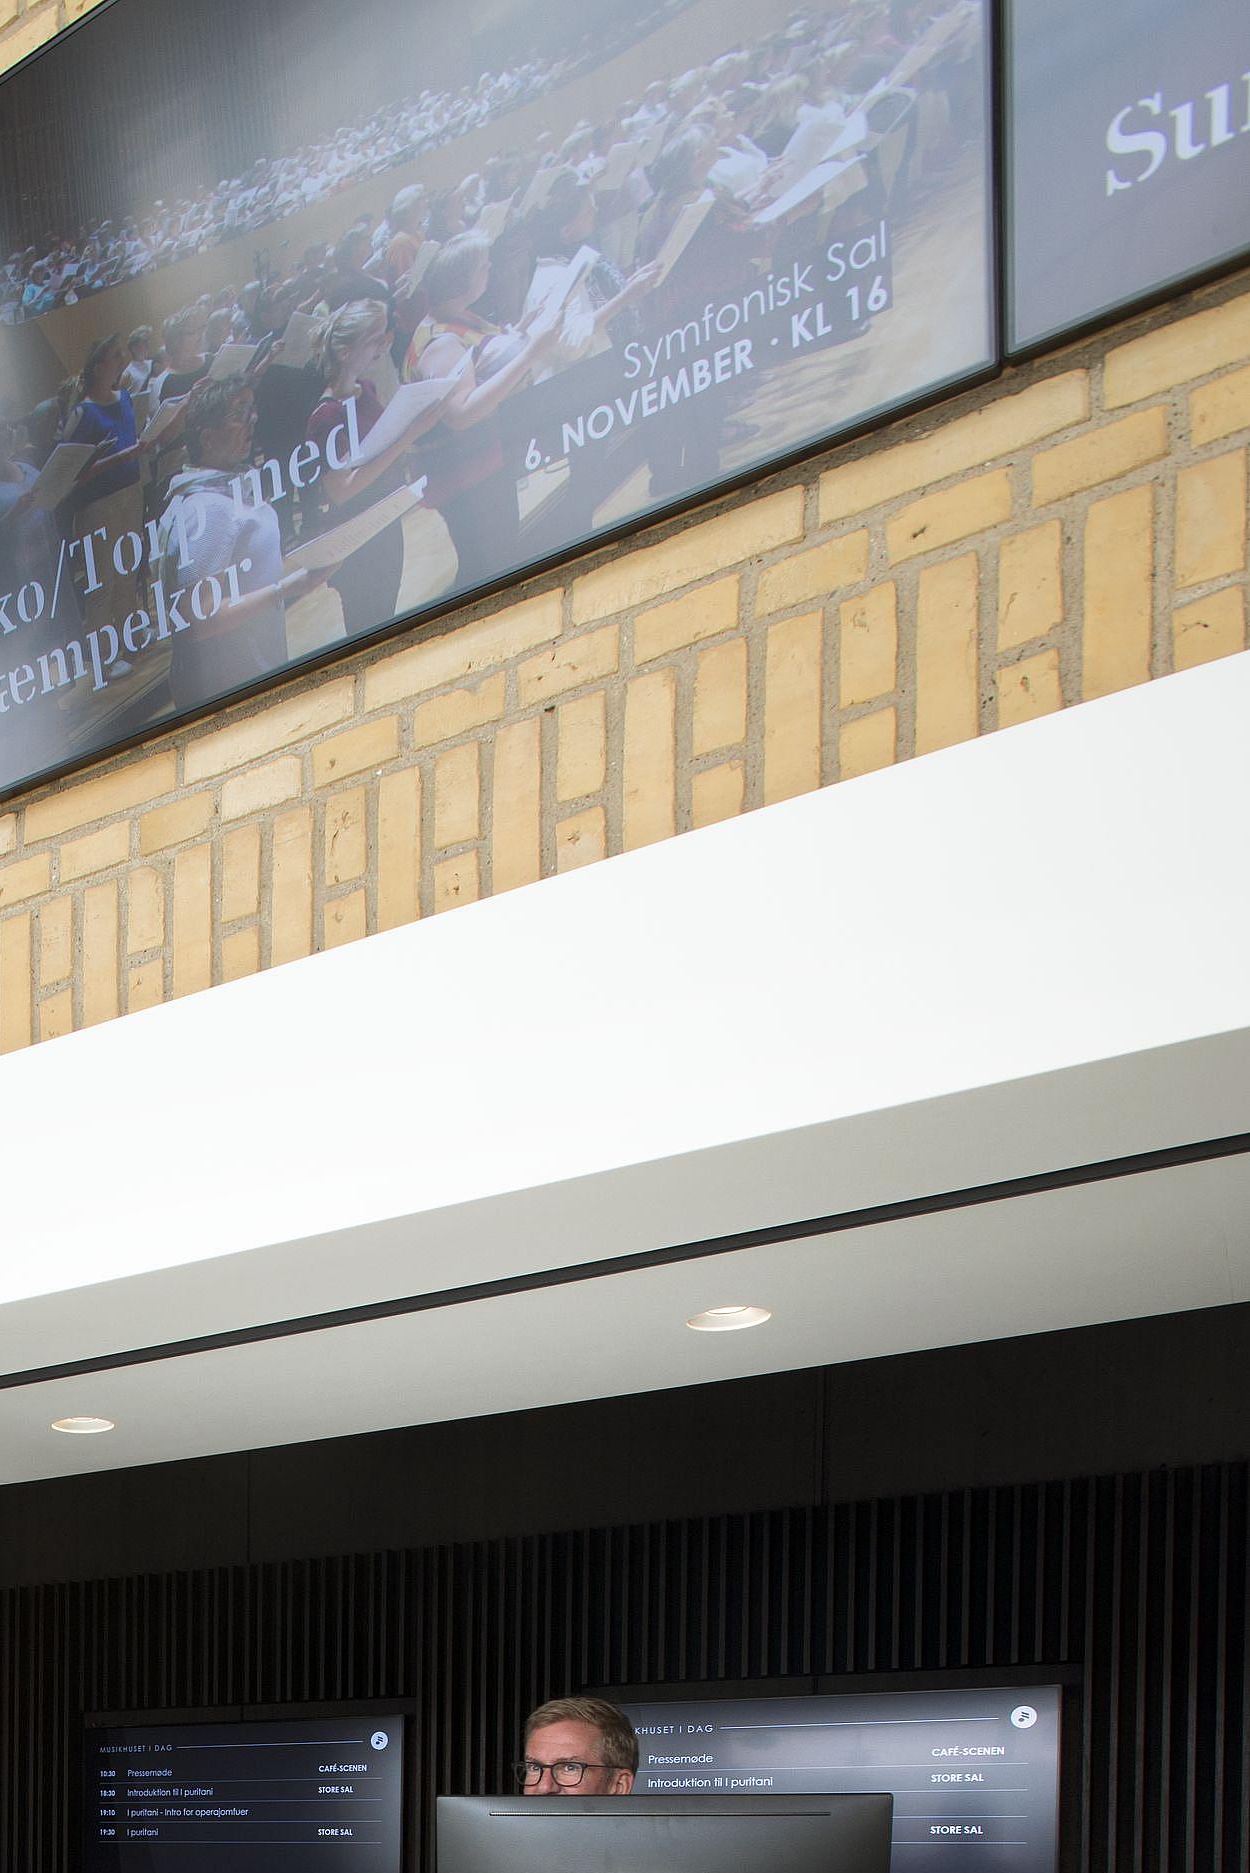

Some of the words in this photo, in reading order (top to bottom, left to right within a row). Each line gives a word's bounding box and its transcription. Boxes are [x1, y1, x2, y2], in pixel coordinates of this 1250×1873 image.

[624, 261, 814, 378] Symfonisk
[827, 220, 886, 281] Sal
[525, 438, 551, 470] 6.
[562, 338, 754, 453] NOVEMBER
[791, 312, 832, 347] KL
[846, 276, 887, 321] 16
[229, 396, 364, 521] med
[634, 1725, 674, 1735] KHUSET
[687, 1725, 713, 1733] DAG
[100, 1745, 145, 1753] MUSIKHUSET
[154, 1744, 172, 1752] DAG
[931, 1746, 1005, 1756] CAFÉ-SCENEN
[649, 1754, 713, 1764] Pressemøde
[318, 1763, 367, 1772] CAFÉ-SCENEN
[127, 1769, 173, 1777] Pressemøde
[931, 1774, 962, 1782] STORE
[964, 1774, 984, 1782] SAL
[648, 1777, 711, 1788] Introduktion
[714, 1777, 723, 1787] til
[731, 1777, 774, 1789] puritani
[127, 1788, 171, 1797] Introduktion
[184, 1787, 214, 1798] puritani
[131, 1809, 159, 1818] puritani
[164, 1808, 182, 1816] Intro
[183, 1808, 194, 1816] for
[195, 1808, 249, 1818] operajomfuer
[130, 1828, 159, 1837] puritani
[930, 1826, 962, 1834] STORE
[963, 1826, 983, 1834] SAL
